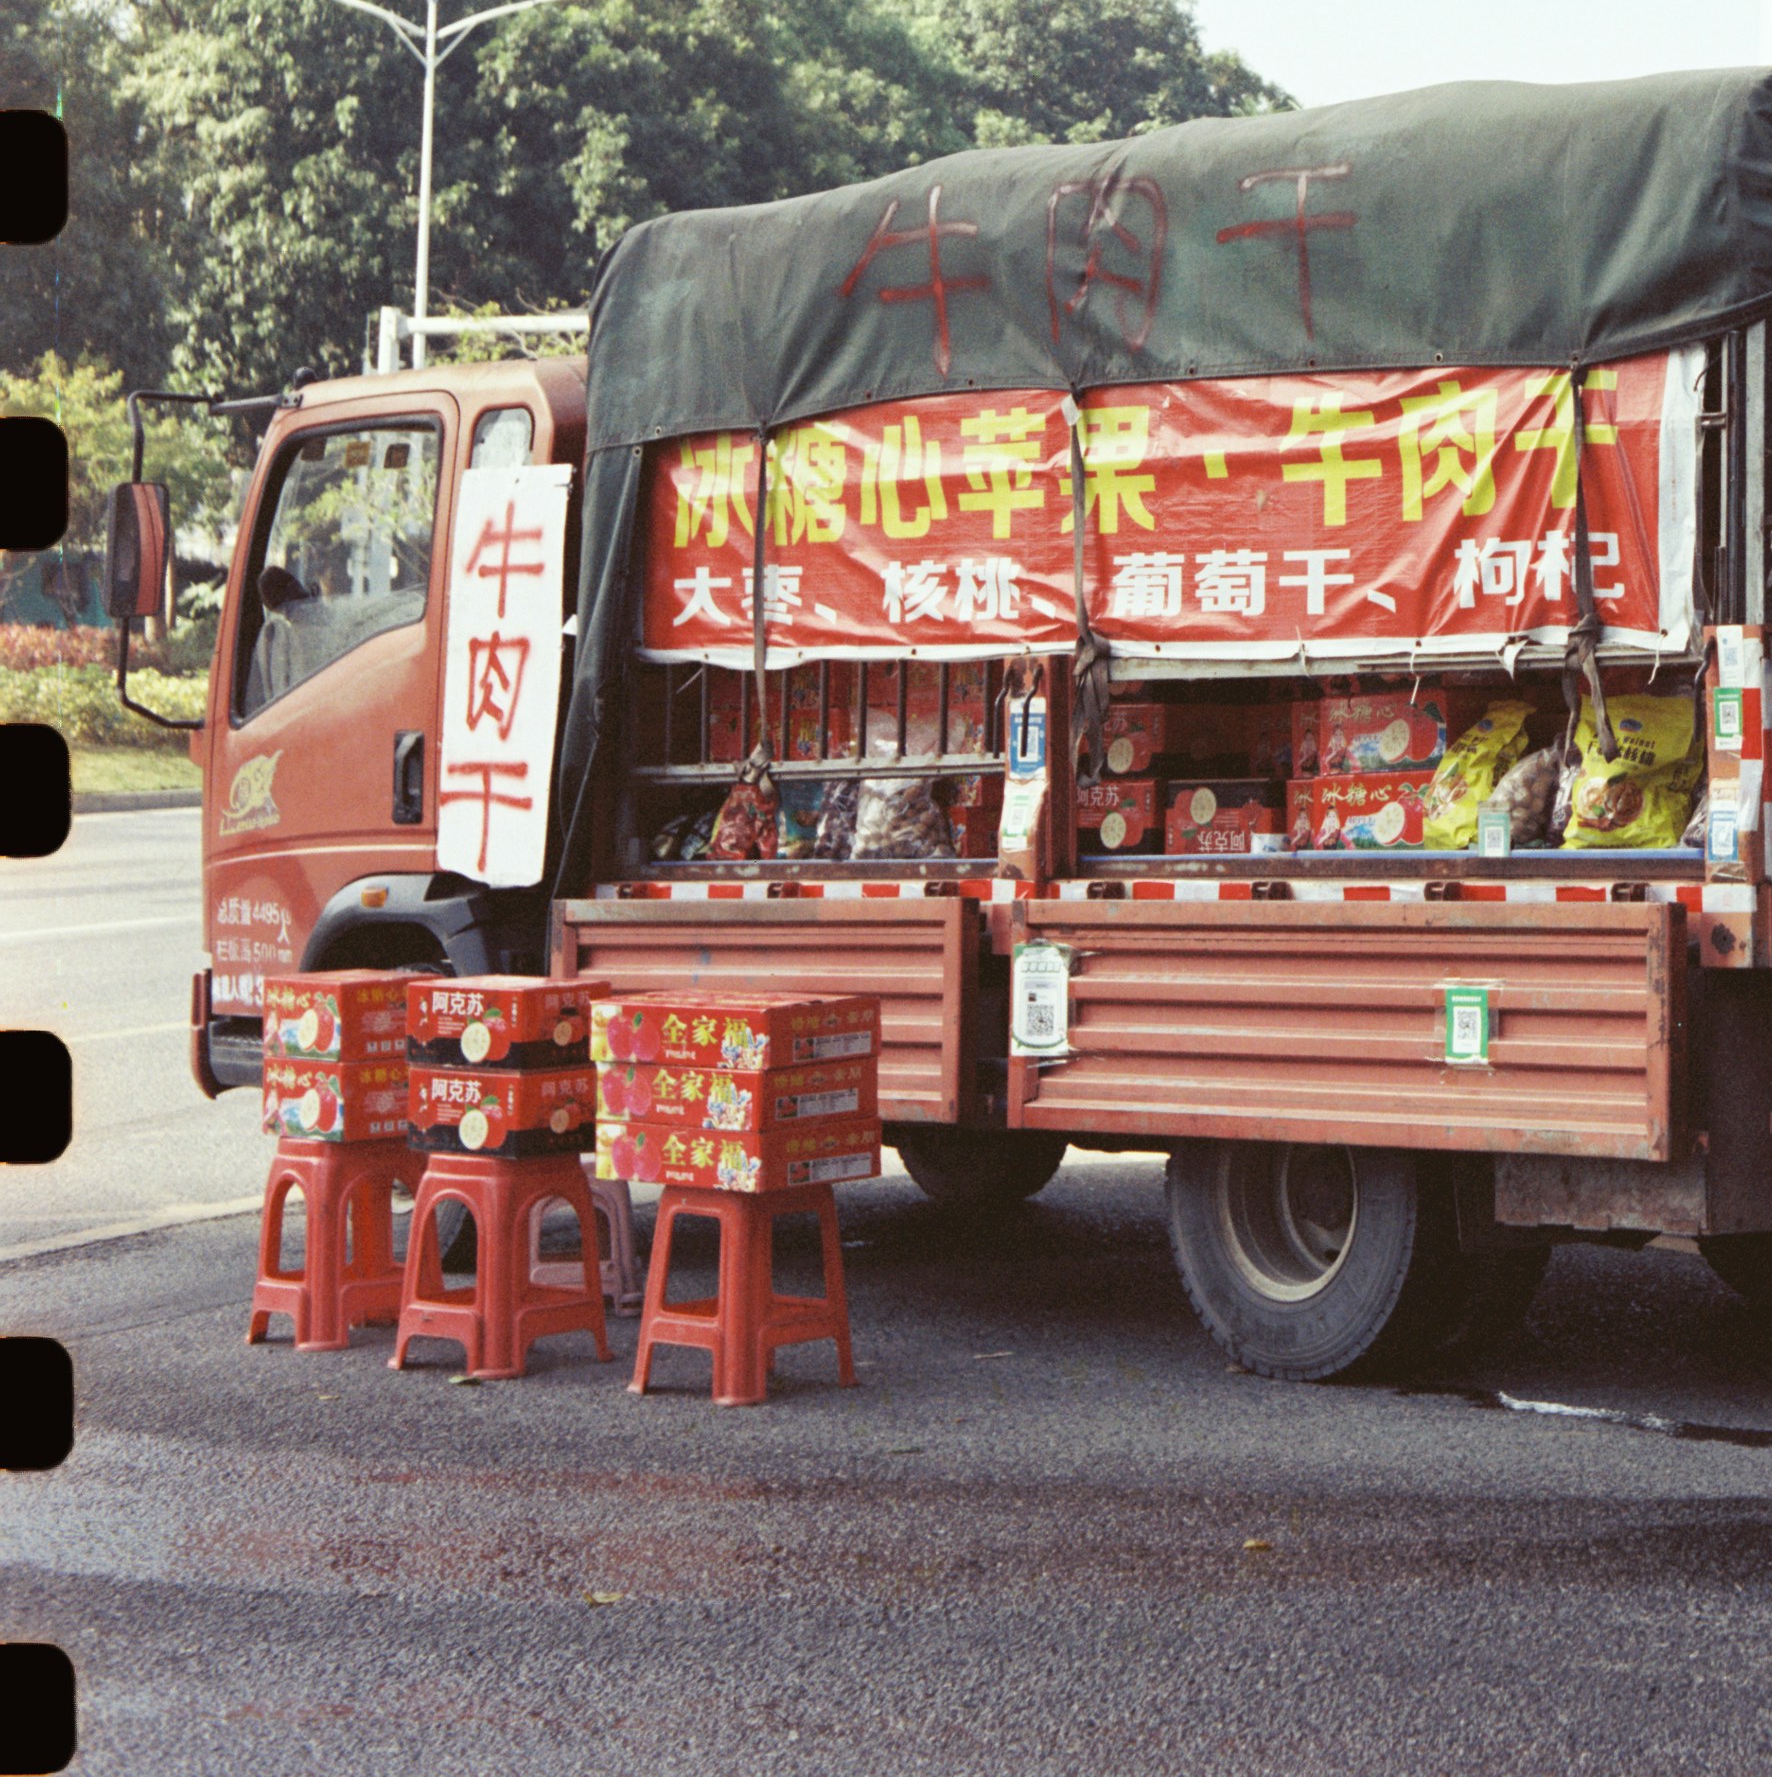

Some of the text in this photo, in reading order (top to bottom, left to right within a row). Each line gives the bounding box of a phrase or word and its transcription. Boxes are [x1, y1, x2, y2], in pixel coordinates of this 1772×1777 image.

[439, 498, 545, 872] 牛肉干
[1321, 782, 1393, 807] 冰糖心
[432, 991, 484, 1016] 阿克苏
[431, 1078, 483, 1103] 阿克苏
